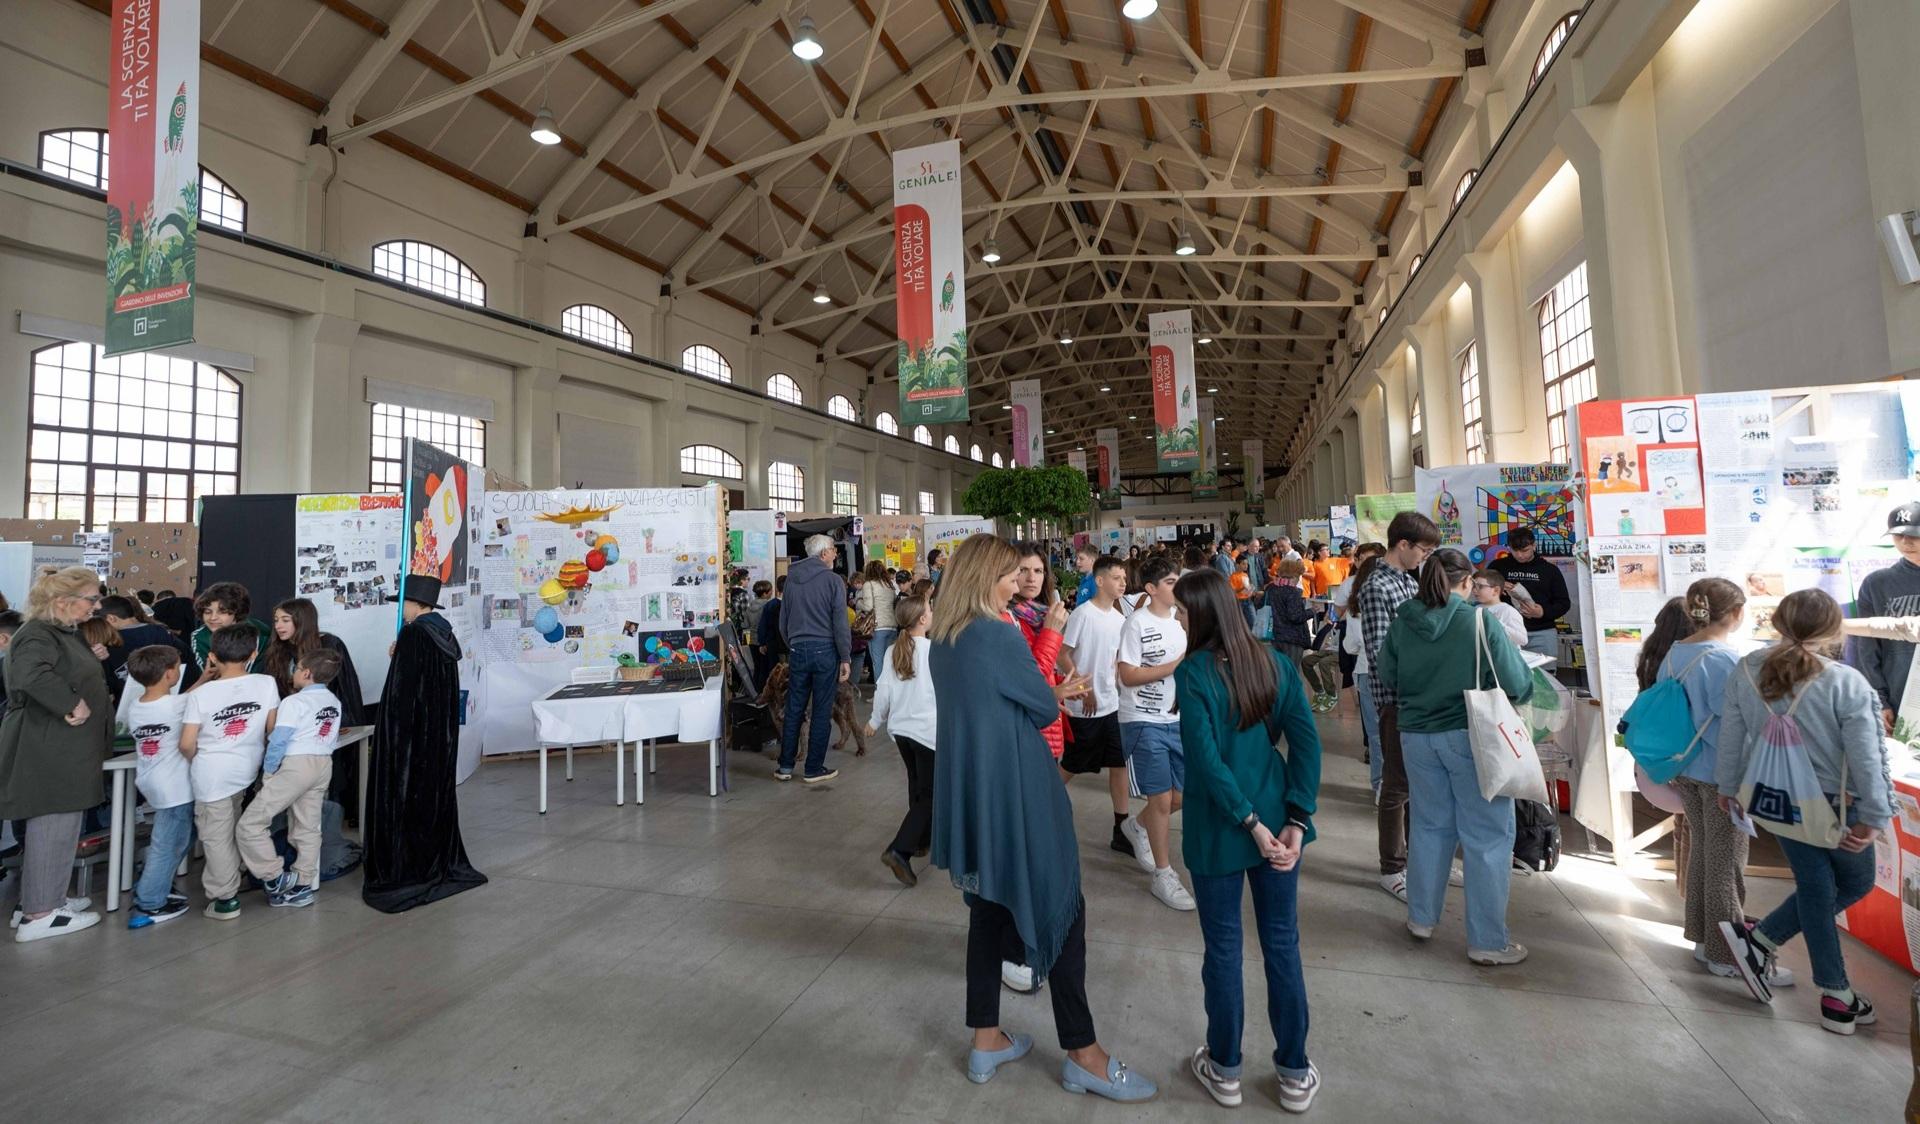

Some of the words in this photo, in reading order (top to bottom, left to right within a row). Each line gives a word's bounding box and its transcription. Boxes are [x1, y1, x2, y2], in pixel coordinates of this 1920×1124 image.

[122, 1, 135, 81] SCIENZA
[136, 0, 151, 73] VOLARE
[121, 84, 133, 110] LA
[136, 75, 149, 99] FA
[134, 104, 149, 122] TI
[898, 170, 958, 190] GENIALE!
[901, 221, 912, 268] SCIENZA
[913, 219, 924, 264] VOLARE
[903, 269, 913, 285] LA
[914, 265, 925, 279] FA
[914, 281, 925, 293] TI
[1500, 466, 1535, 476] SCULTURE
[1540, 465, 1568, 475] LIBERE
[492, 492, 551, 513] SCUOLA
